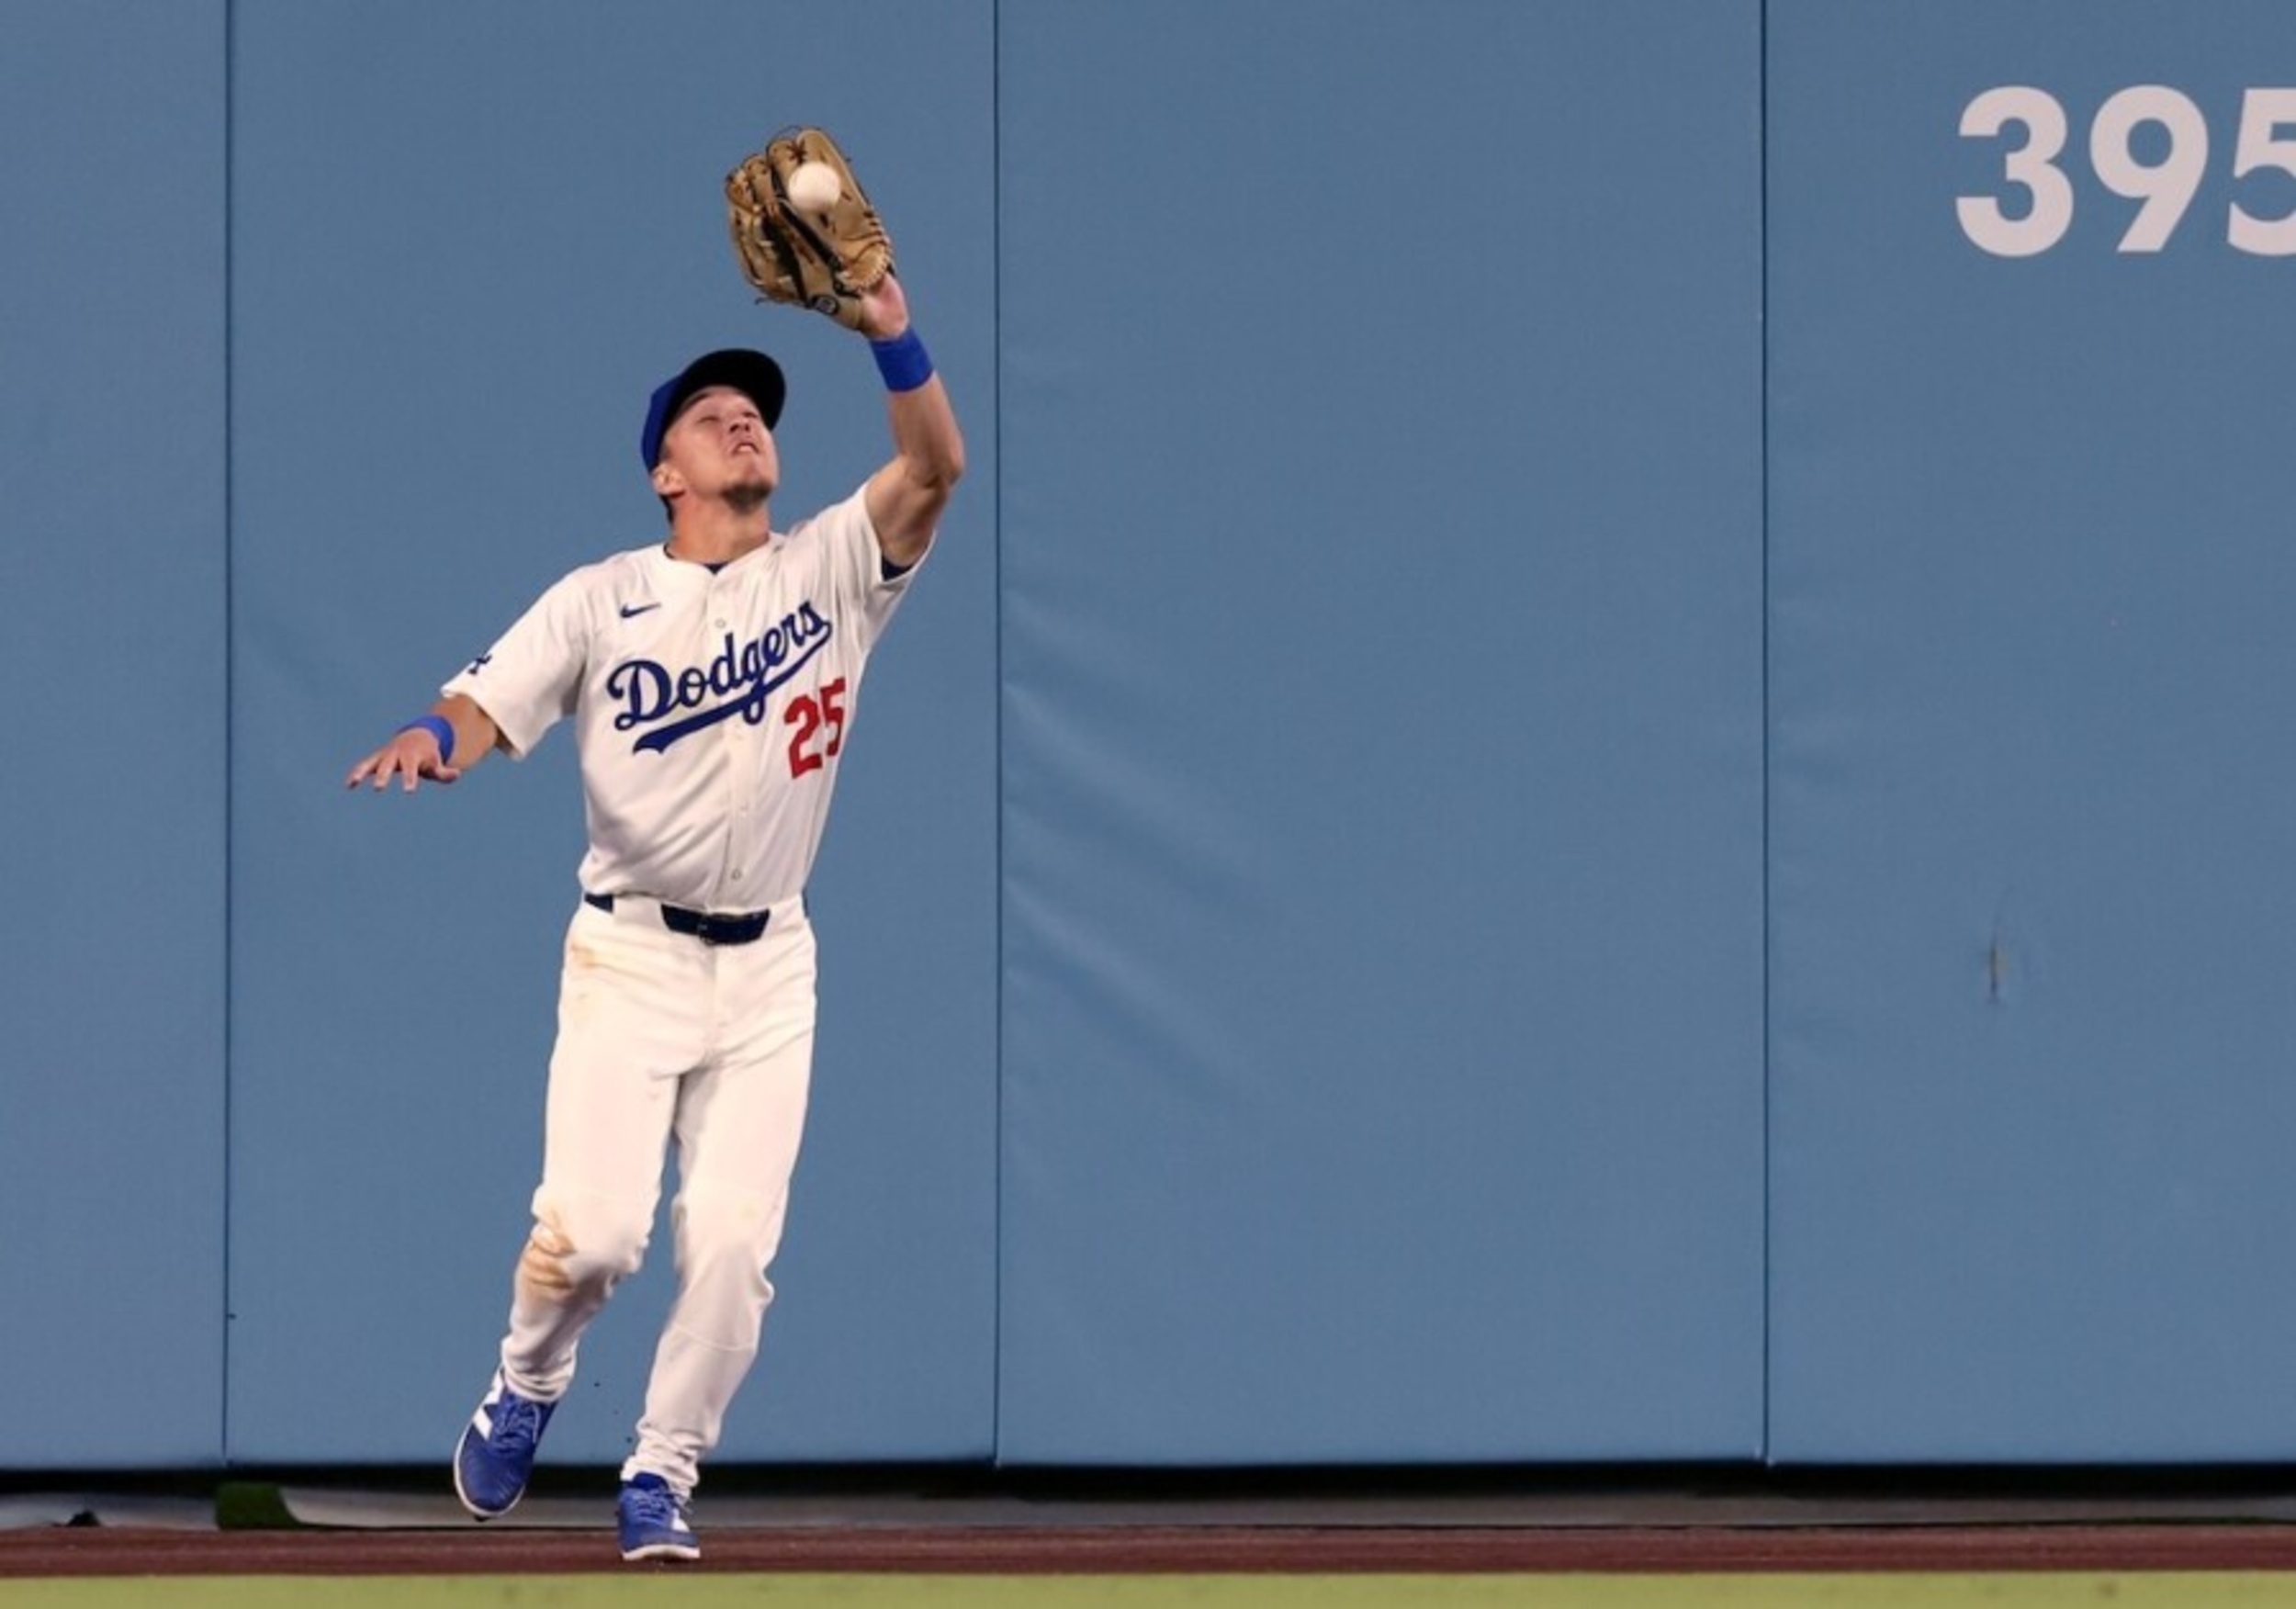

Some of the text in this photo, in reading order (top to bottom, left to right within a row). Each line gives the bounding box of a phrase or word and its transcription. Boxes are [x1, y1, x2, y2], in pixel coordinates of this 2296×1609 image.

[1955, 84, 2296, 257] 395
[606, 601, 832, 755] Dodgers
[783, 677, 846, 779] 25
